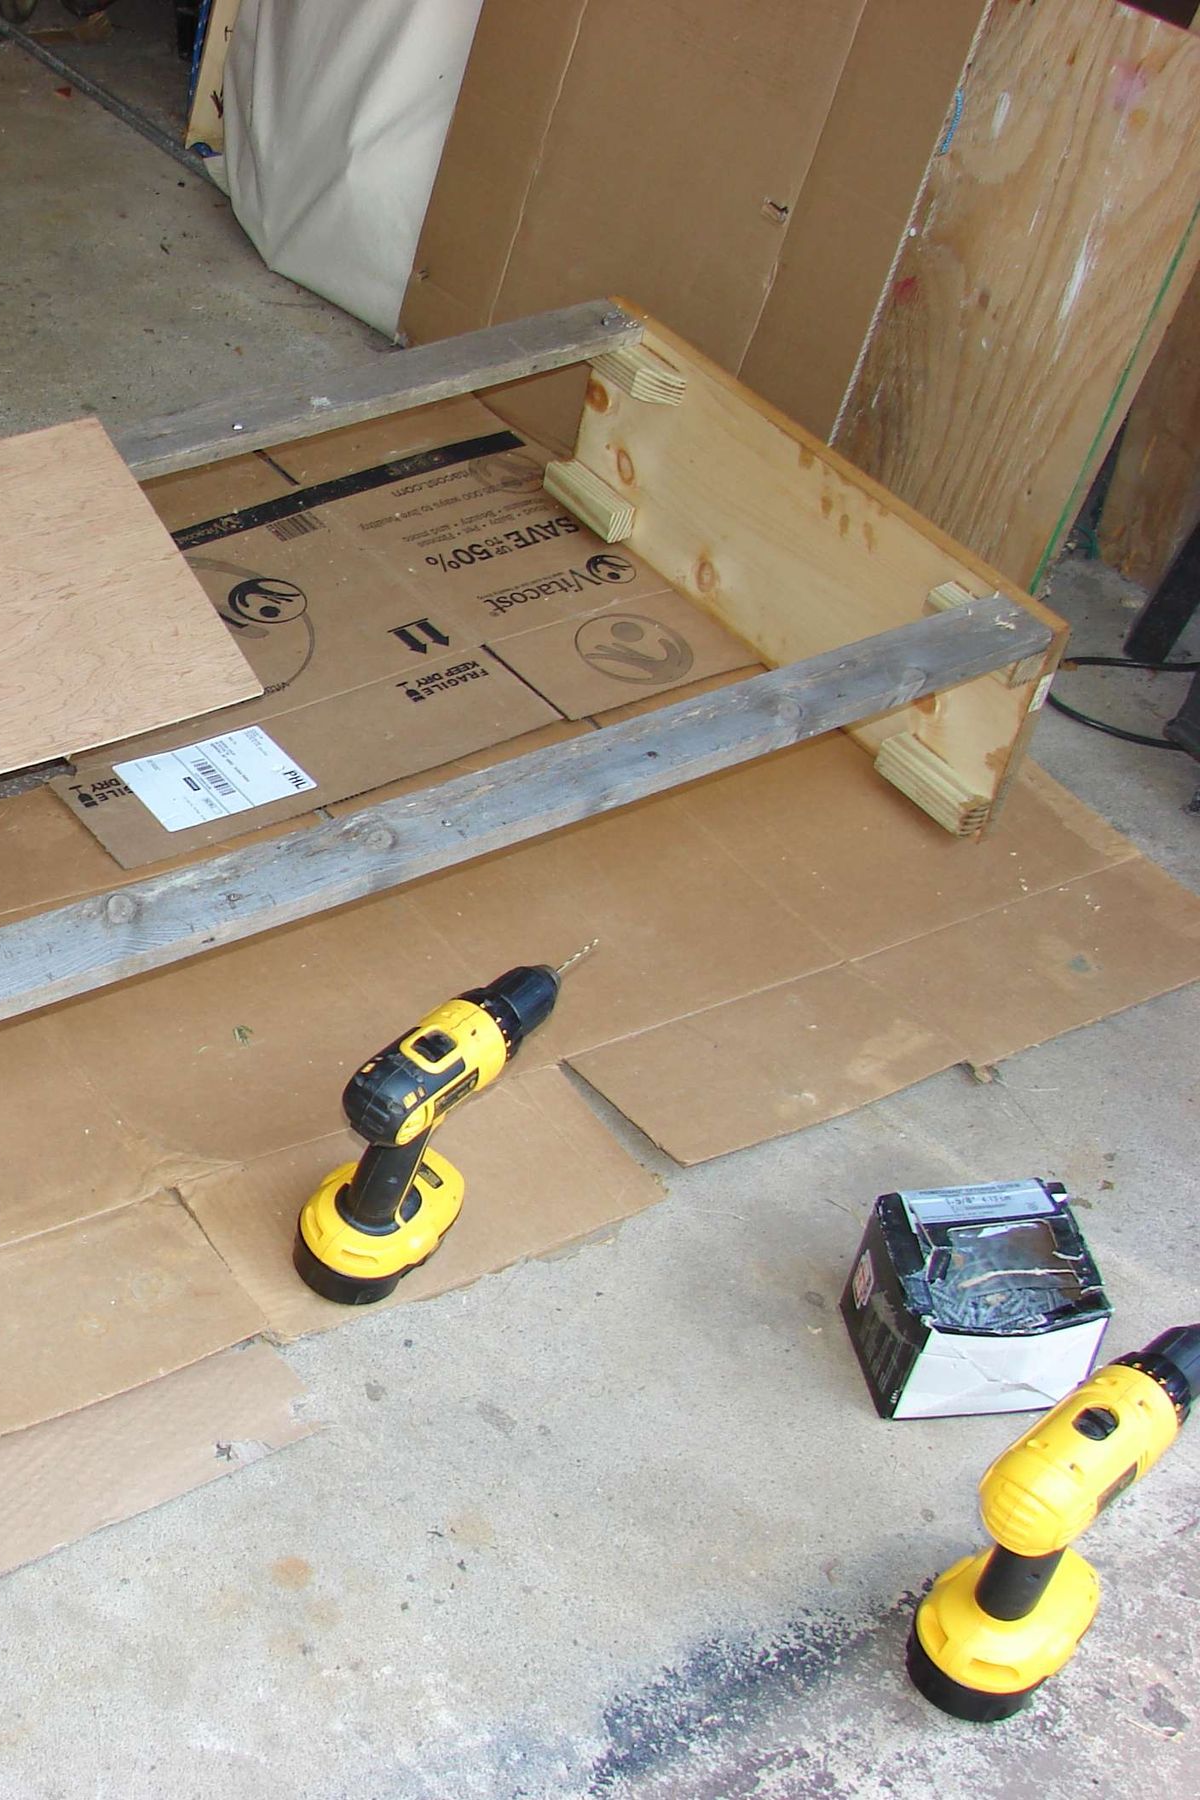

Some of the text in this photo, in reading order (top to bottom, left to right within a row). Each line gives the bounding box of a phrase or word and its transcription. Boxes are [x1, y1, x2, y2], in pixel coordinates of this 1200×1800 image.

[484, 536, 503, 548] TO
[504, 516, 581, 549] SAVE
[425, 543, 494, 572] 50%
[496, 545, 513, 556] UP
[483, 569, 602, 614] Vitacost
[416, 661, 480, 688] KEEP DRY
[421, 668, 489, 696] FRAGILE
[90, 778, 121, 793] DRY
[283, 769, 308, 790] PHL
